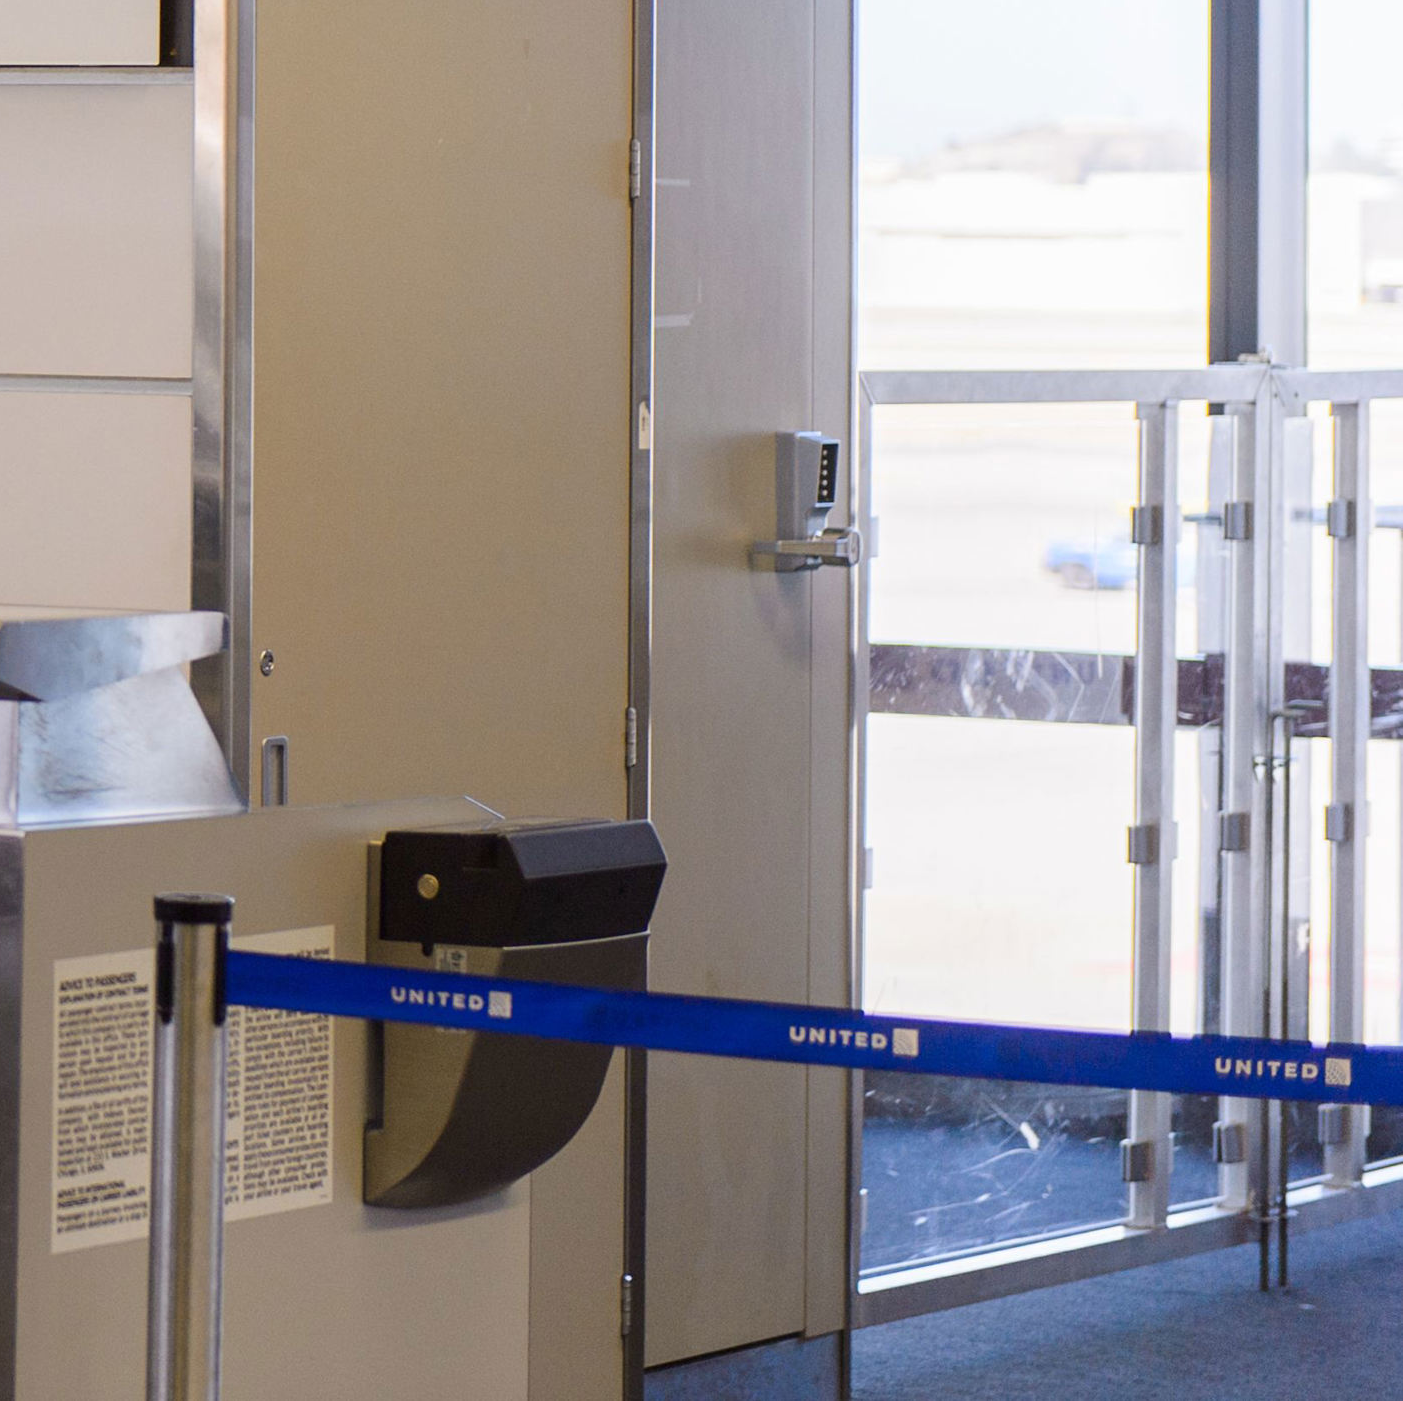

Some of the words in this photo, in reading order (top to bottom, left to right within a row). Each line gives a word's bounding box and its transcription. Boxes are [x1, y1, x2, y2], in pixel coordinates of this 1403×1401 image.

[391, 986, 485, 1011] UNITED
[789, 1025, 887, 1050] UNITED
[1215, 1057, 1319, 1080] UNITED
